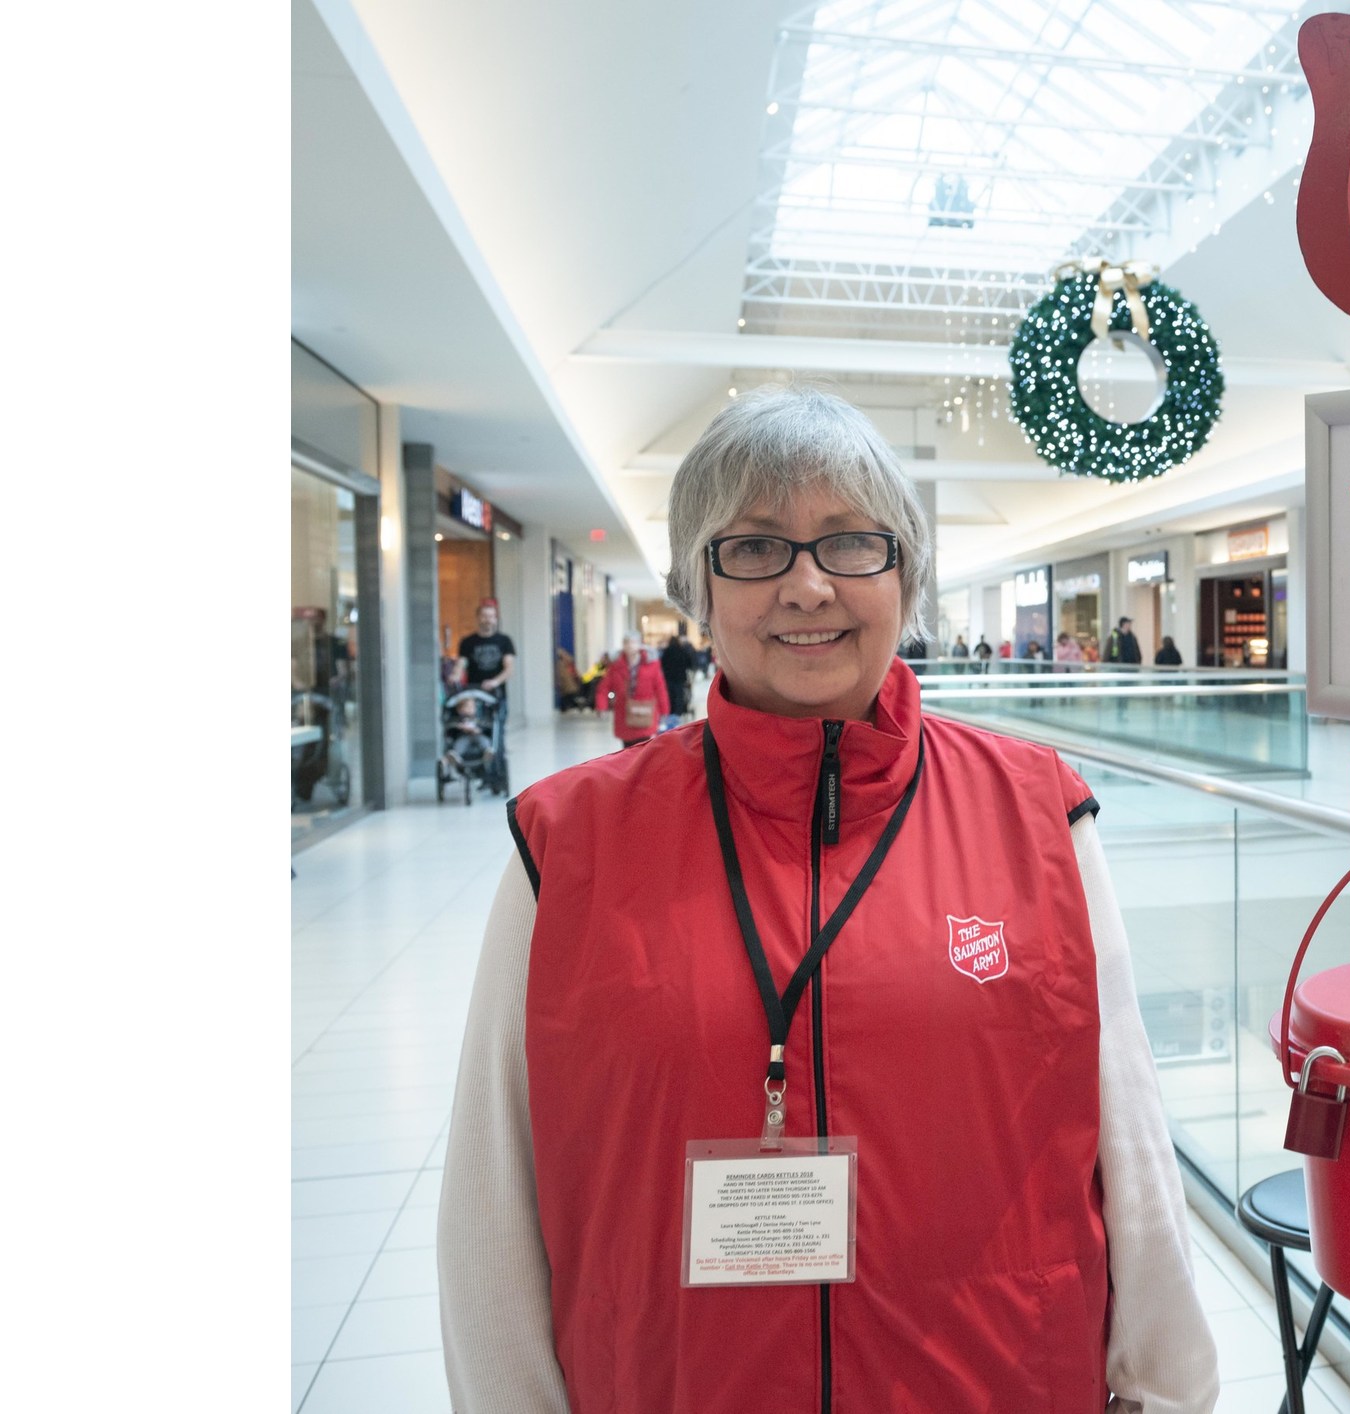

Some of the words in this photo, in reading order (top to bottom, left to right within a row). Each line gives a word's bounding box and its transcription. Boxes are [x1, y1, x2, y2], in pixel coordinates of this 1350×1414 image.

[828, 774, 836, 831] STORMTECH
[958, 923, 981, 943] THE
[953, 931, 1000, 962] SALVATION
[973, 948, 1000, 973] ARMY
[726, 1173, 756, 1181] REMINDER
